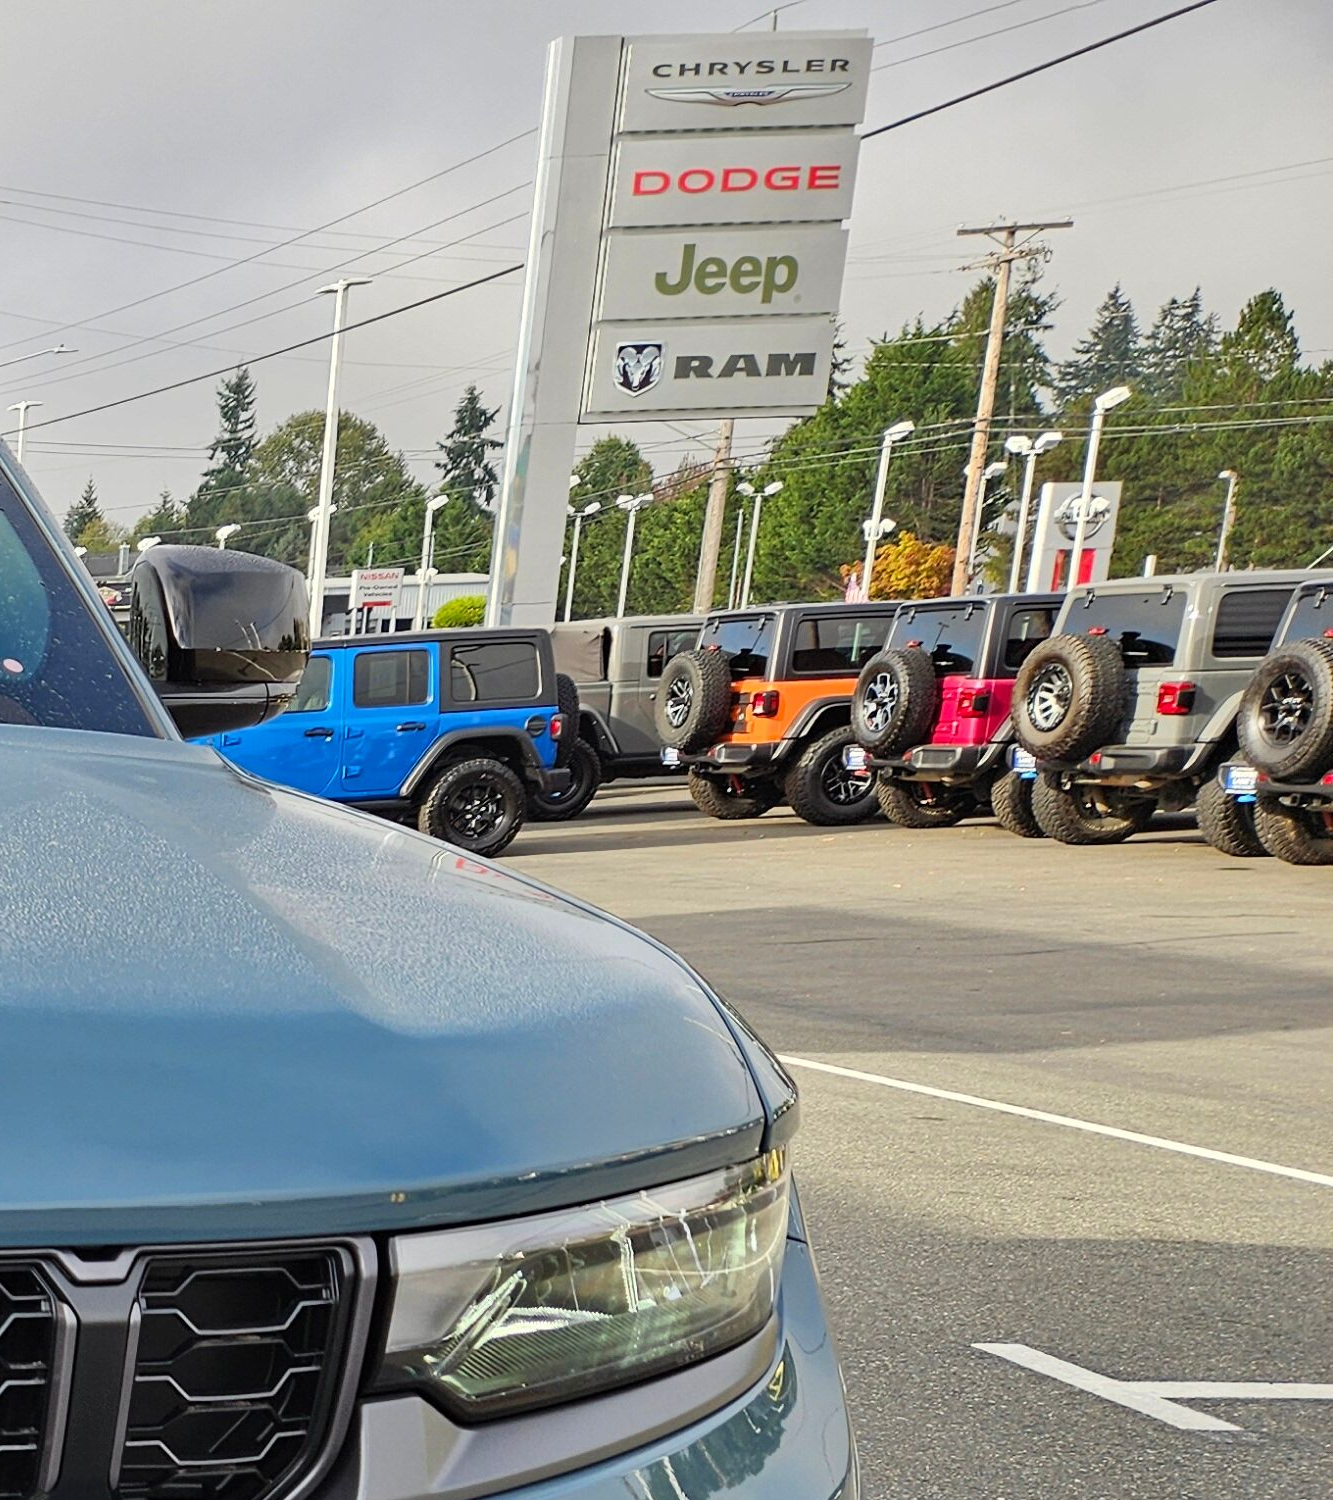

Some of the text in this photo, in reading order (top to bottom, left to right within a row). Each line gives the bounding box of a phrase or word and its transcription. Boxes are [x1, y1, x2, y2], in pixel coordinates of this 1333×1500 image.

[652, 59, 850, 78] CHRYSLER
[633, 165, 841, 196] DODGE
[654, 243, 799, 304] Jeep
[674, 352, 817, 380] RAM
[360, 572, 399, 580] NISSAN
